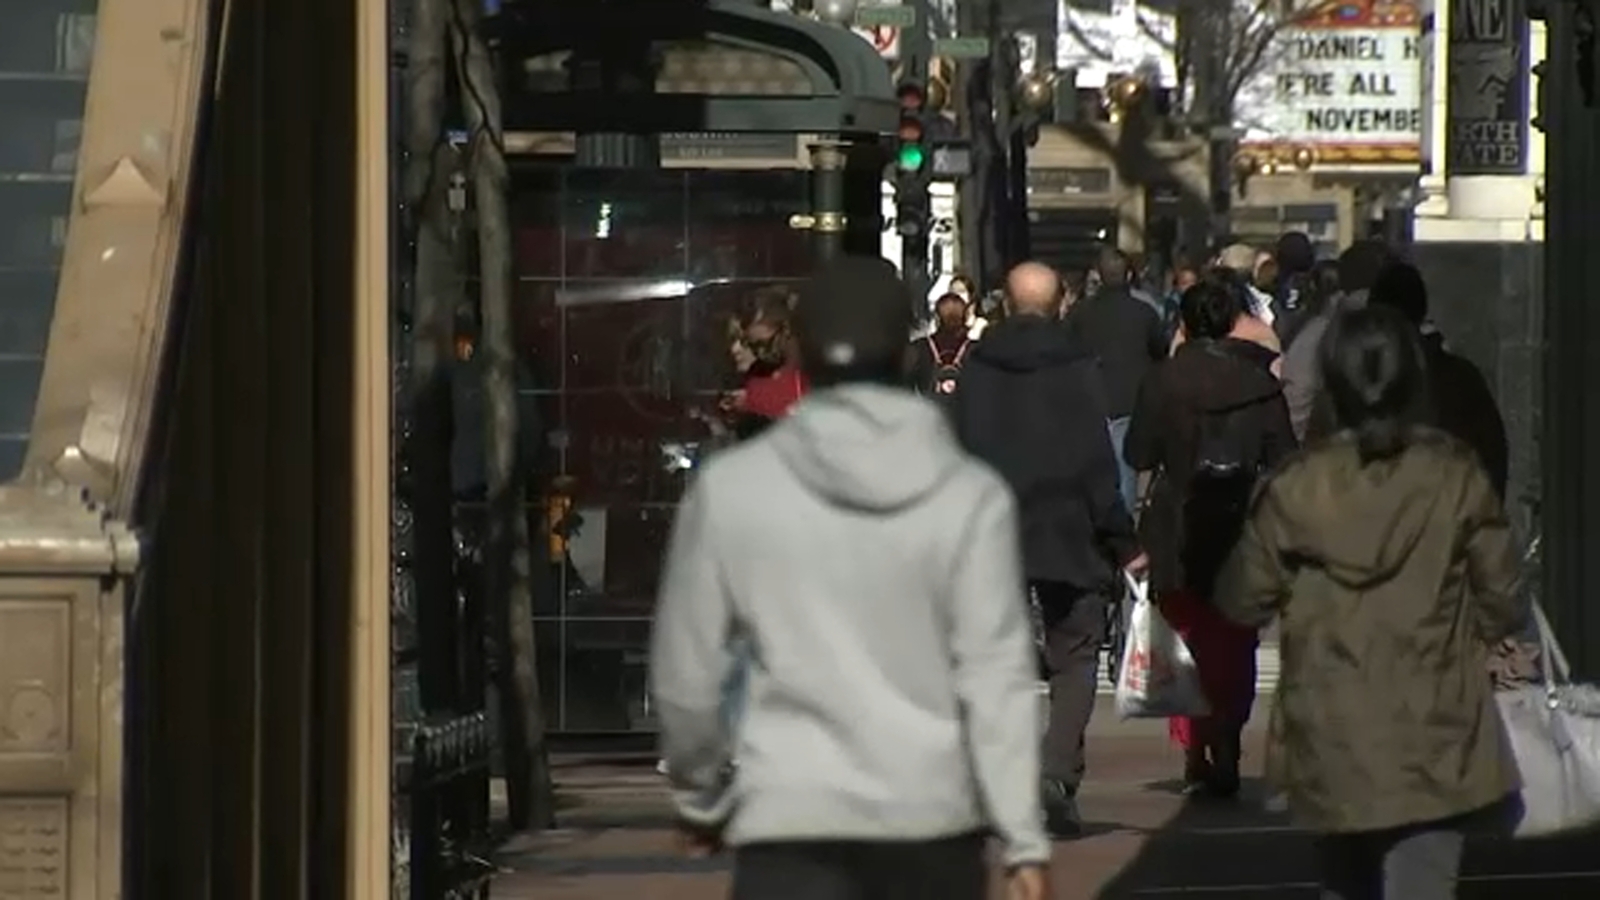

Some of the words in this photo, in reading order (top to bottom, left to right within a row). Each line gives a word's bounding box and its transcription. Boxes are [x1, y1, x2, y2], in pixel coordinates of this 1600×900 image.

[1298, 36, 1383, 60] DANIEL
[1277, 71, 1334, 97] E'RE
[1348, 71, 1396, 97] ALL
[1306, 107, 1420, 132] NOVEMBE
